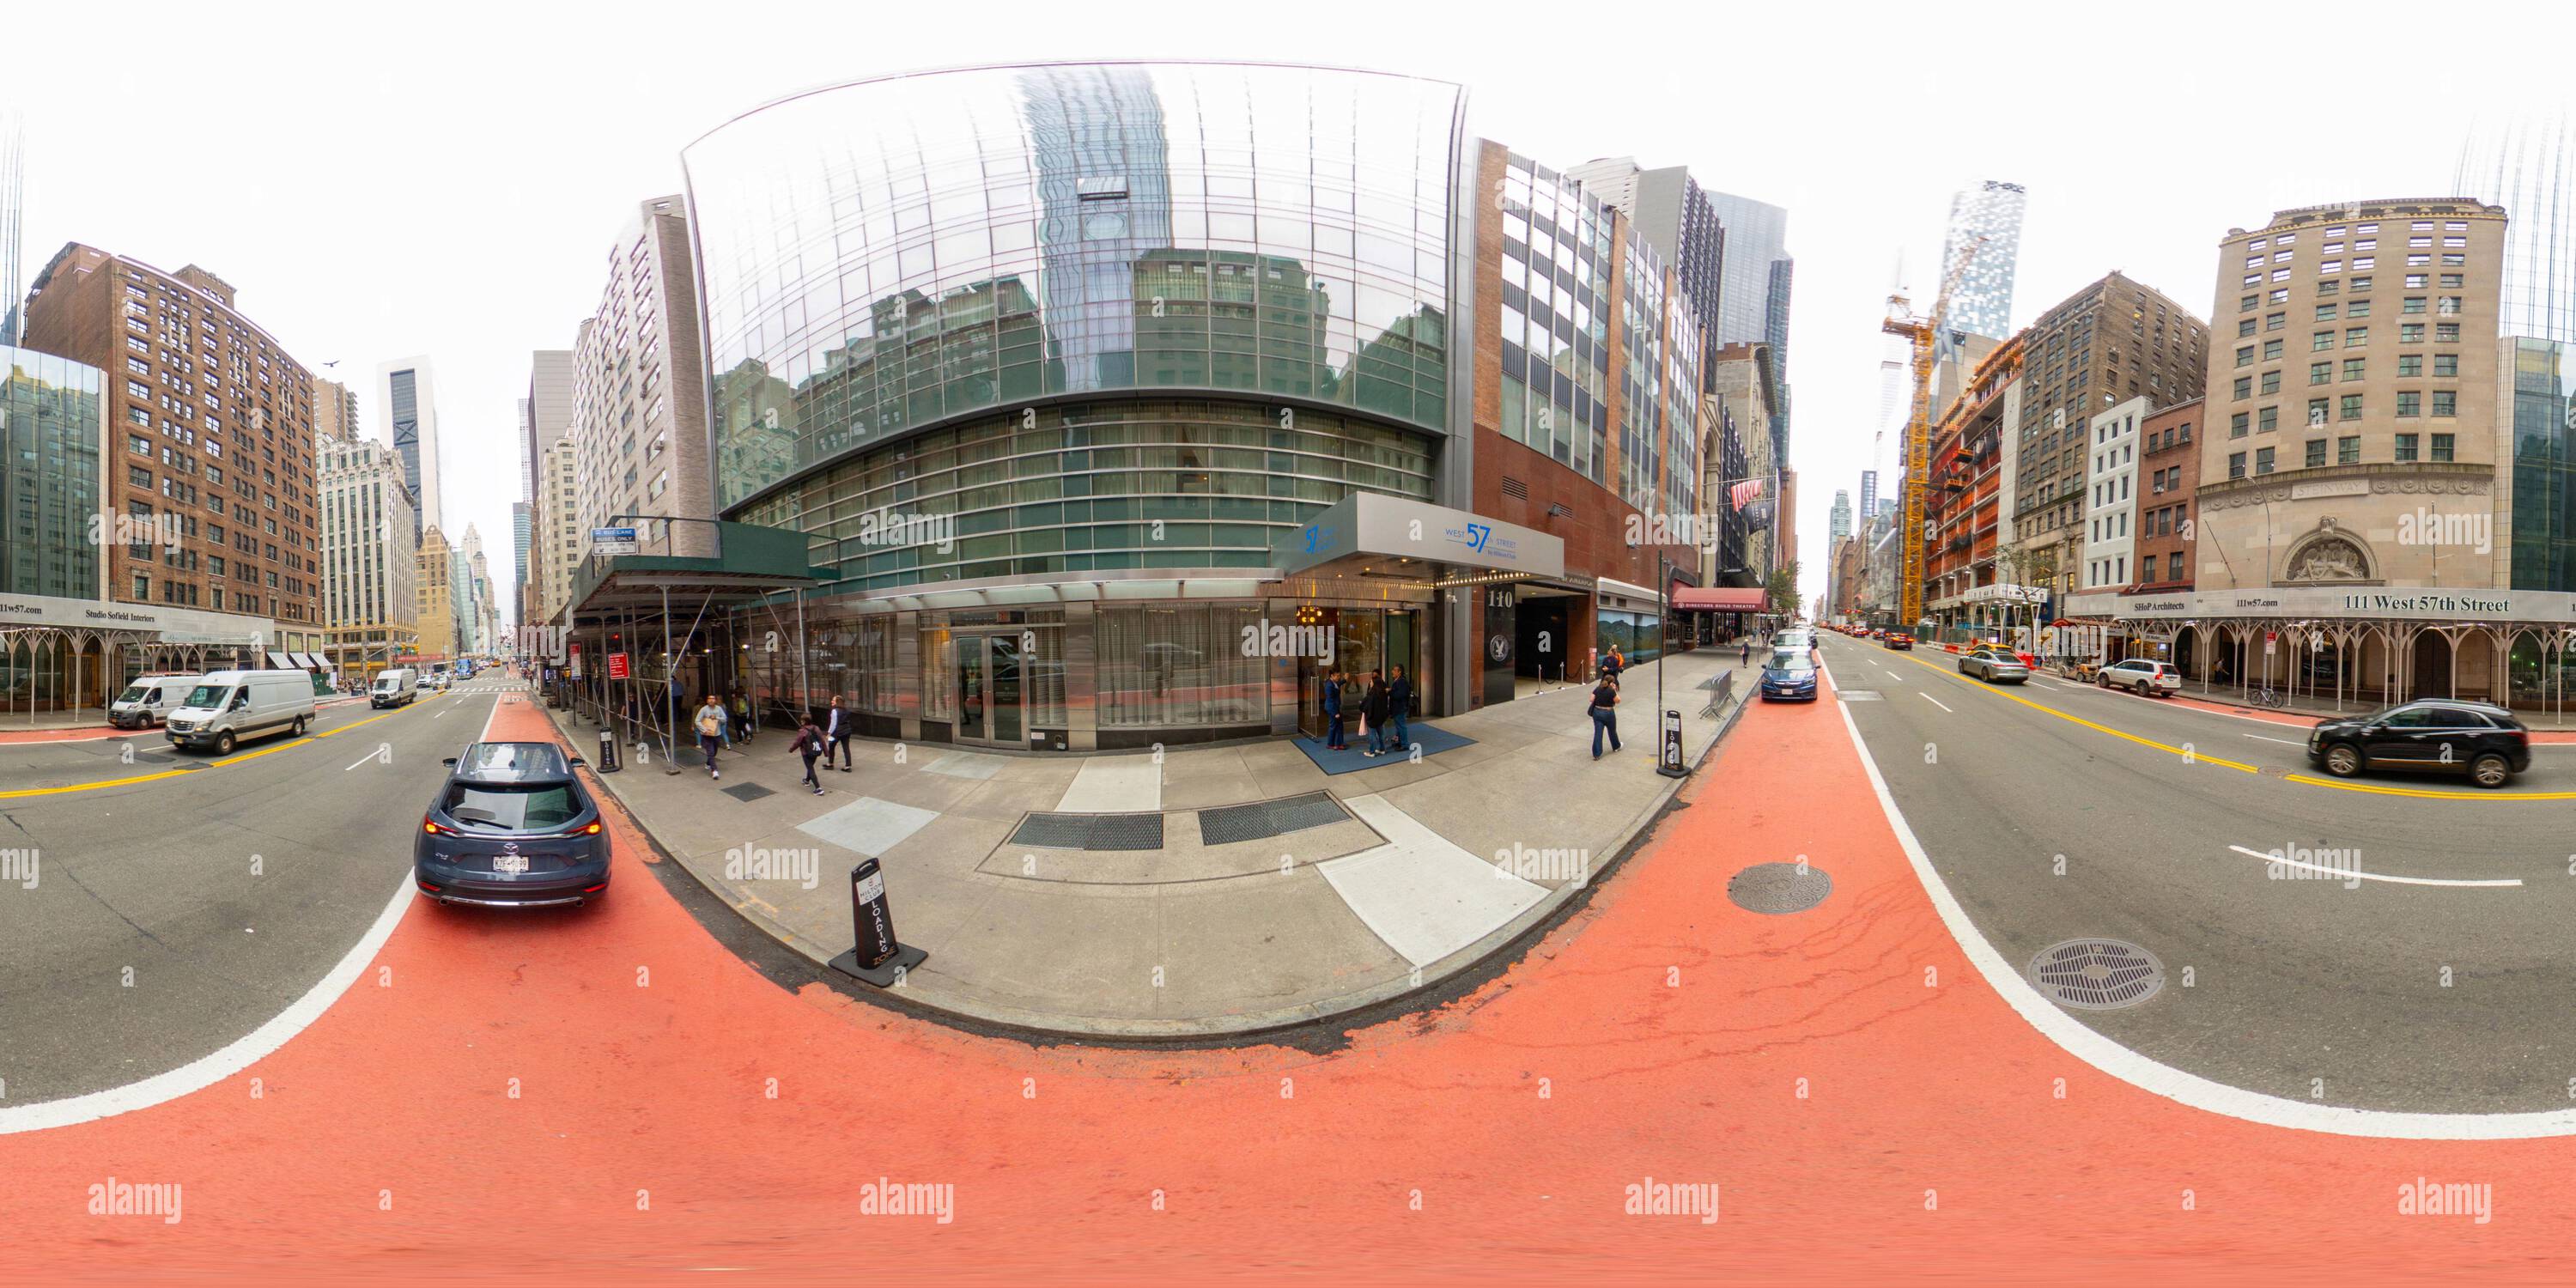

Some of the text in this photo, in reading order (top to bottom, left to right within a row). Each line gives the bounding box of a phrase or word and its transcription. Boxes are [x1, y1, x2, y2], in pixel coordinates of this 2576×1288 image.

[2297, 481, 2361, 496] STEINWAY
[1445, 528, 1465, 538] WEST
[1466, 523, 1492, 553] 57
[1496, 538, 1516, 549] STREET
[1488, 590, 1513, 608] 110
[2135, 602, 2184, 611] SHoP Architects
[2345, 595, 2509, 611] 111 West 57th Street
[86, 610, 155, 623] Studio Sofield Interiors
[860, 883, 882, 898] HILTON
[872, 900, 888, 953] LOADING
